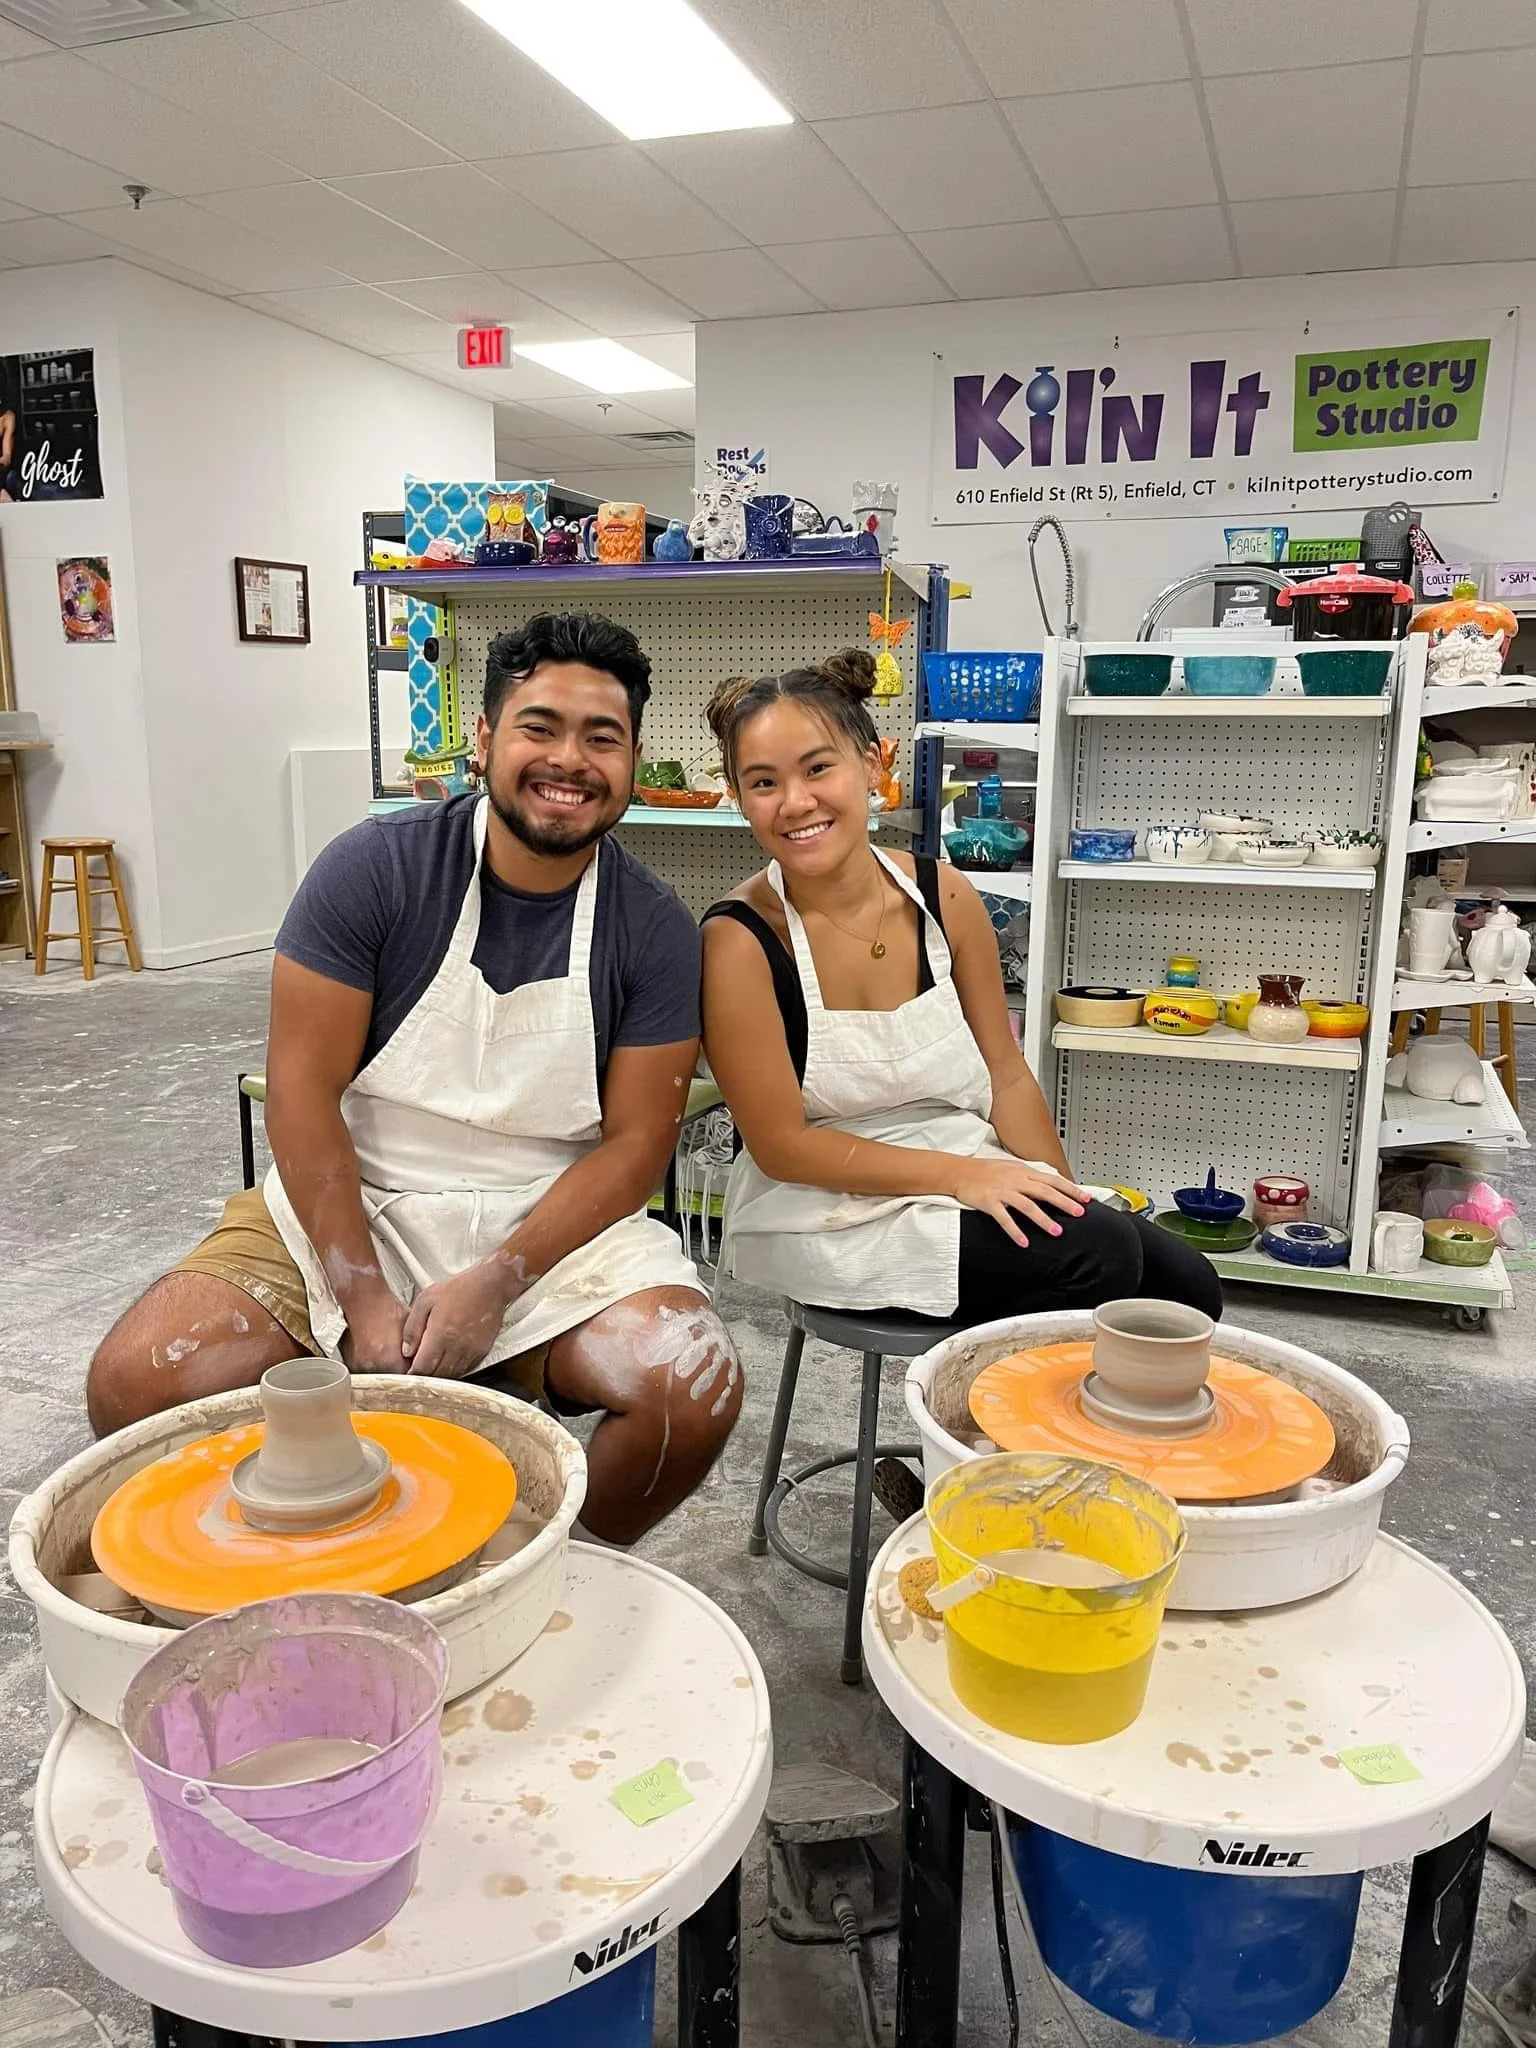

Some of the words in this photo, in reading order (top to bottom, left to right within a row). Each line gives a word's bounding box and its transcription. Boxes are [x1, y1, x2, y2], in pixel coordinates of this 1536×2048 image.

[466, 330, 503, 365] EXIT
[1308, 358, 1477, 397] Pottery
[1190, 360, 1270, 459] It
[1315, 394, 1458, 437] Studio
[717, 447, 749, 461] Rest
[956, 489, 984, 504] 610
[990, 486, 1043, 503] Enfield
[1049, 487, 1066, 501] St
[1071, 486, 1093, 503] (Rt
[1098, 484, 1117, 501] 5),
[1124, 480, 1186, 498] Enfield,
[1193, 479, 1217, 495] CT
[1247, 466, 1473, 494] kilnitpotterystudio.com
[1236, 537, 1262, 555] SAGE
[1509, 573, 1530, 584] SAM
[1199, 1839, 1315, 1867] Nidec
[568, 1907, 672, 1984] Nidec
